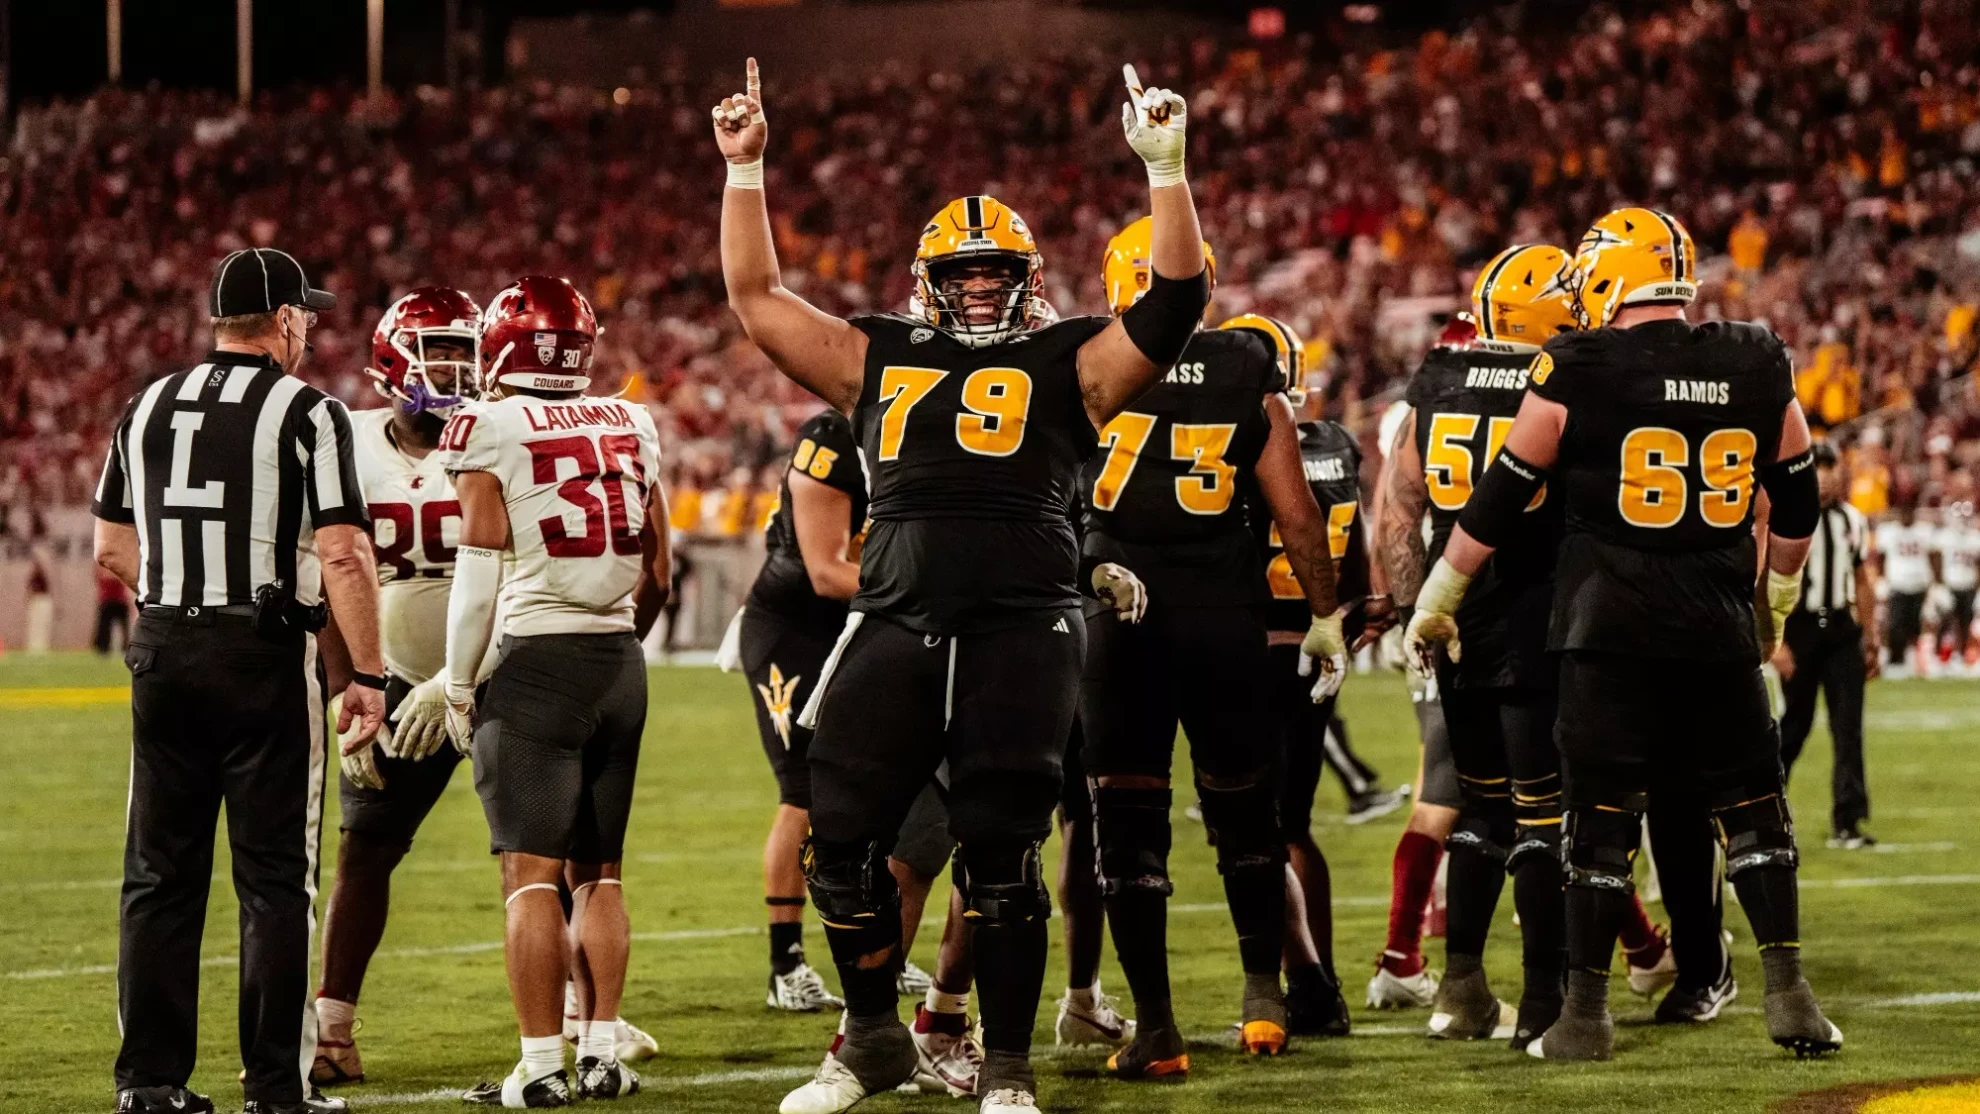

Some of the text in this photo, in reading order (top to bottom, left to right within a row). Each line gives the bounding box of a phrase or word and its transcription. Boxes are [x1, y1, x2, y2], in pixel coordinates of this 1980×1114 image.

[1654, 286, 1673, 297] SUN
[562, 349, 581, 368] 30
[533, 377, 575, 389] COUGARS
[1160, 362, 1205, 385] ASS
[1465, 366, 1531, 390] BRIGGS
[1664, 379, 1730, 405] RAMOS
[879, 366, 1032, 462] 79
[164, 410, 225, 509] L
[1093, 411, 1238, 515] 73
[1618, 427, 1757, 528] 69
[520, 434, 645, 558] 30
